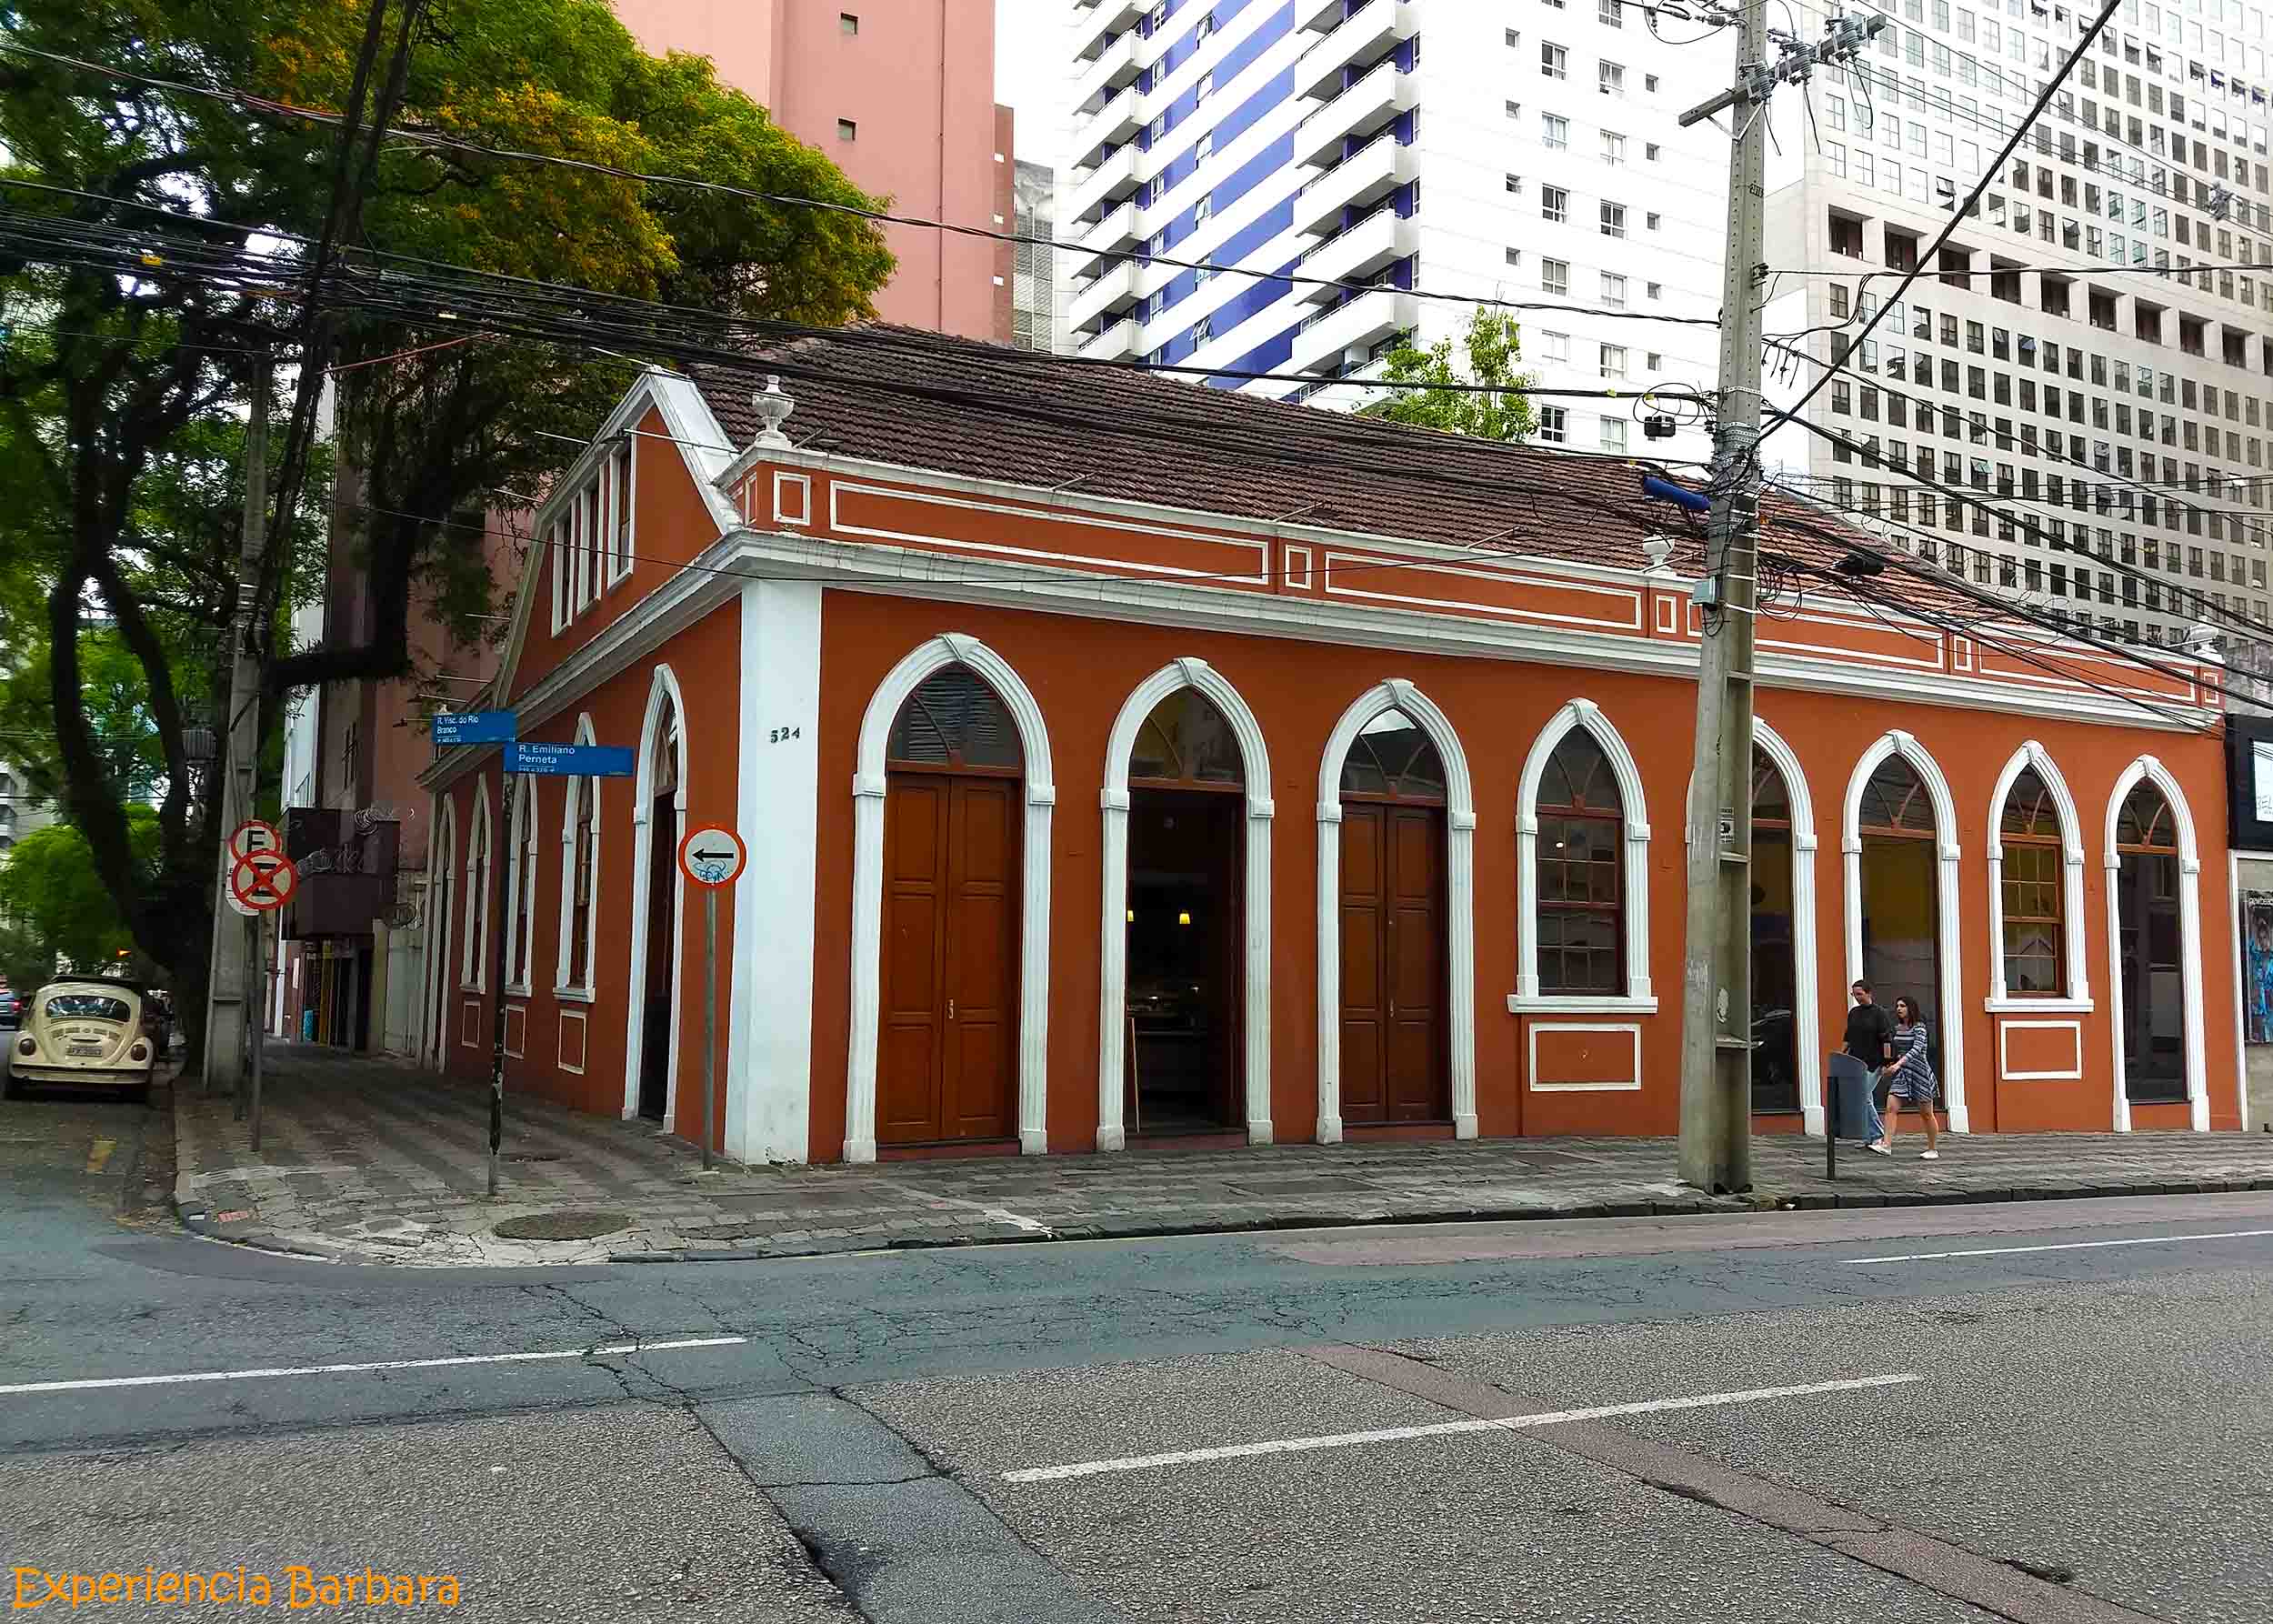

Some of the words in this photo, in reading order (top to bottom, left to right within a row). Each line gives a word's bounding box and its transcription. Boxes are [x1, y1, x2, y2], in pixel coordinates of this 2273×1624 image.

[467, 715, 479, 724] Rio
[770, 727, 800, 743] 524
[532, 745, 576, 755] Emiliano
[518, 754, 557, 764] Perneta
